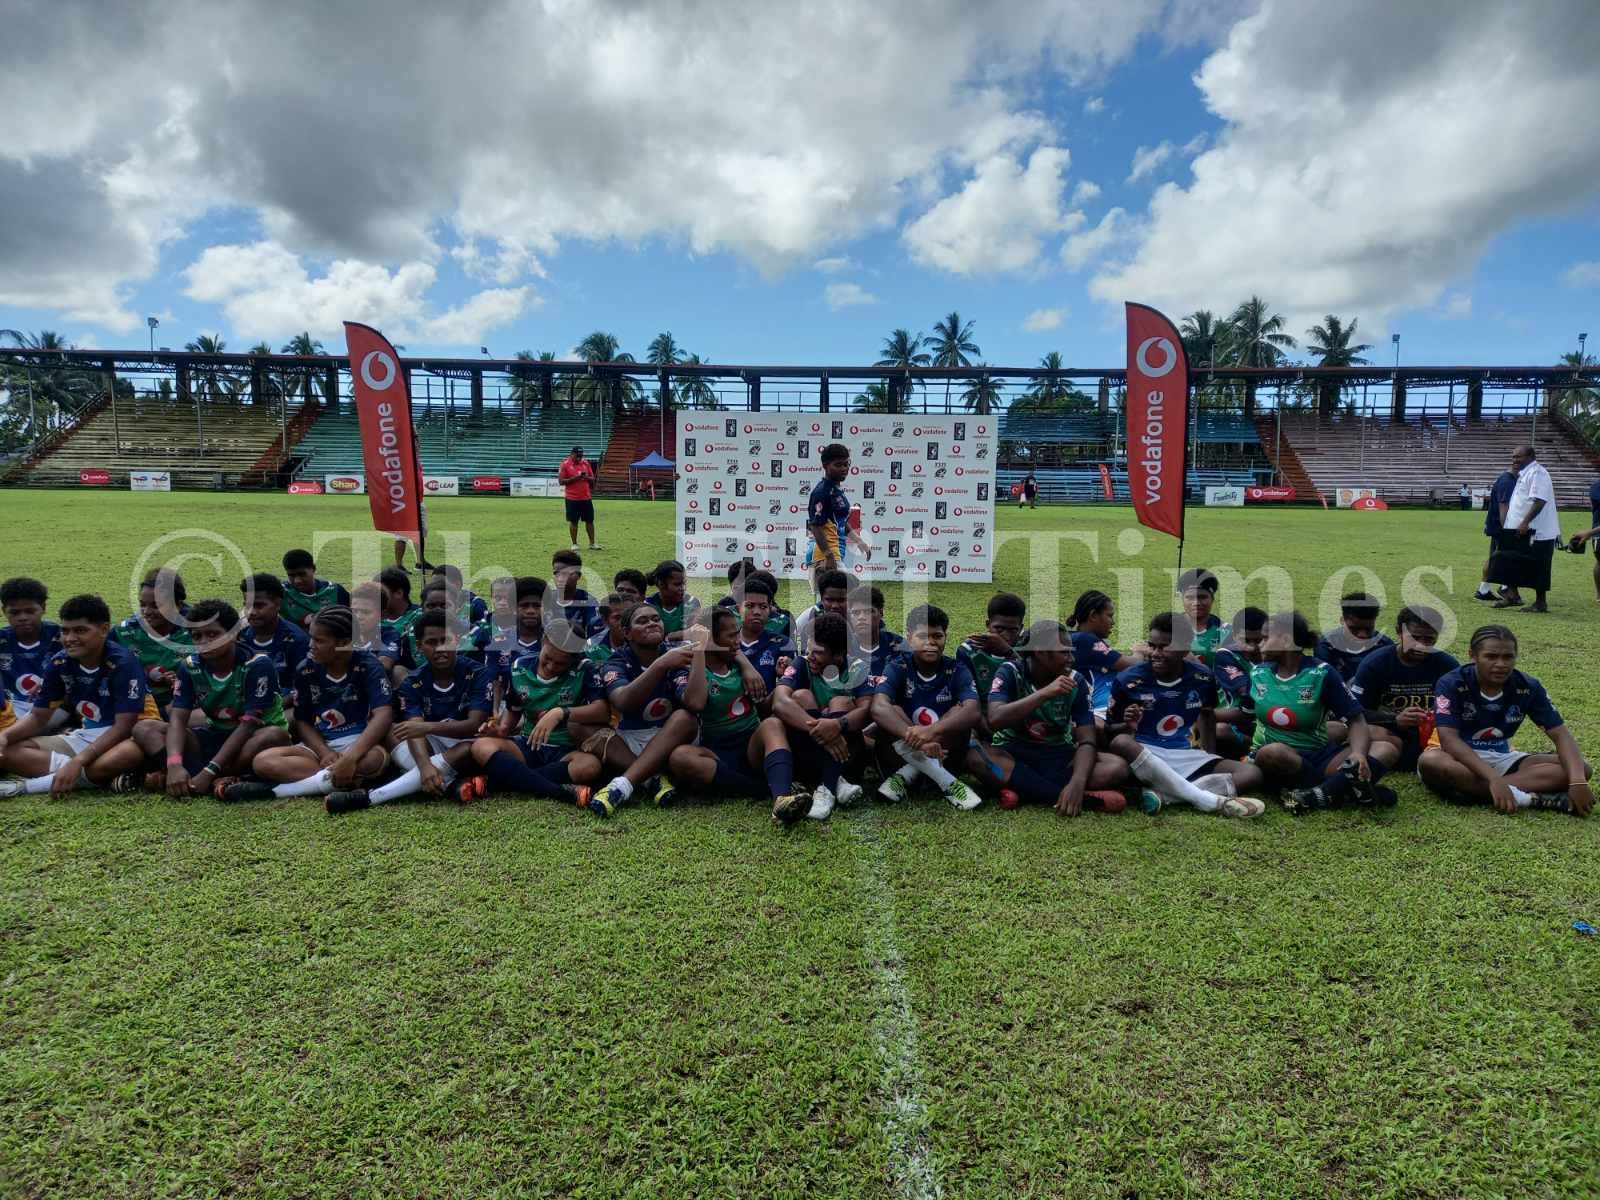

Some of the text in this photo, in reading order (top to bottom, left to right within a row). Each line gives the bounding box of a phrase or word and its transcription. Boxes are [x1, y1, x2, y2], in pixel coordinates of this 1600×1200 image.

[332, 479, 356, 489] Shan
[377, 402, 406, 514] vodafone
[1141, 390, 1164, 505] vodafone
